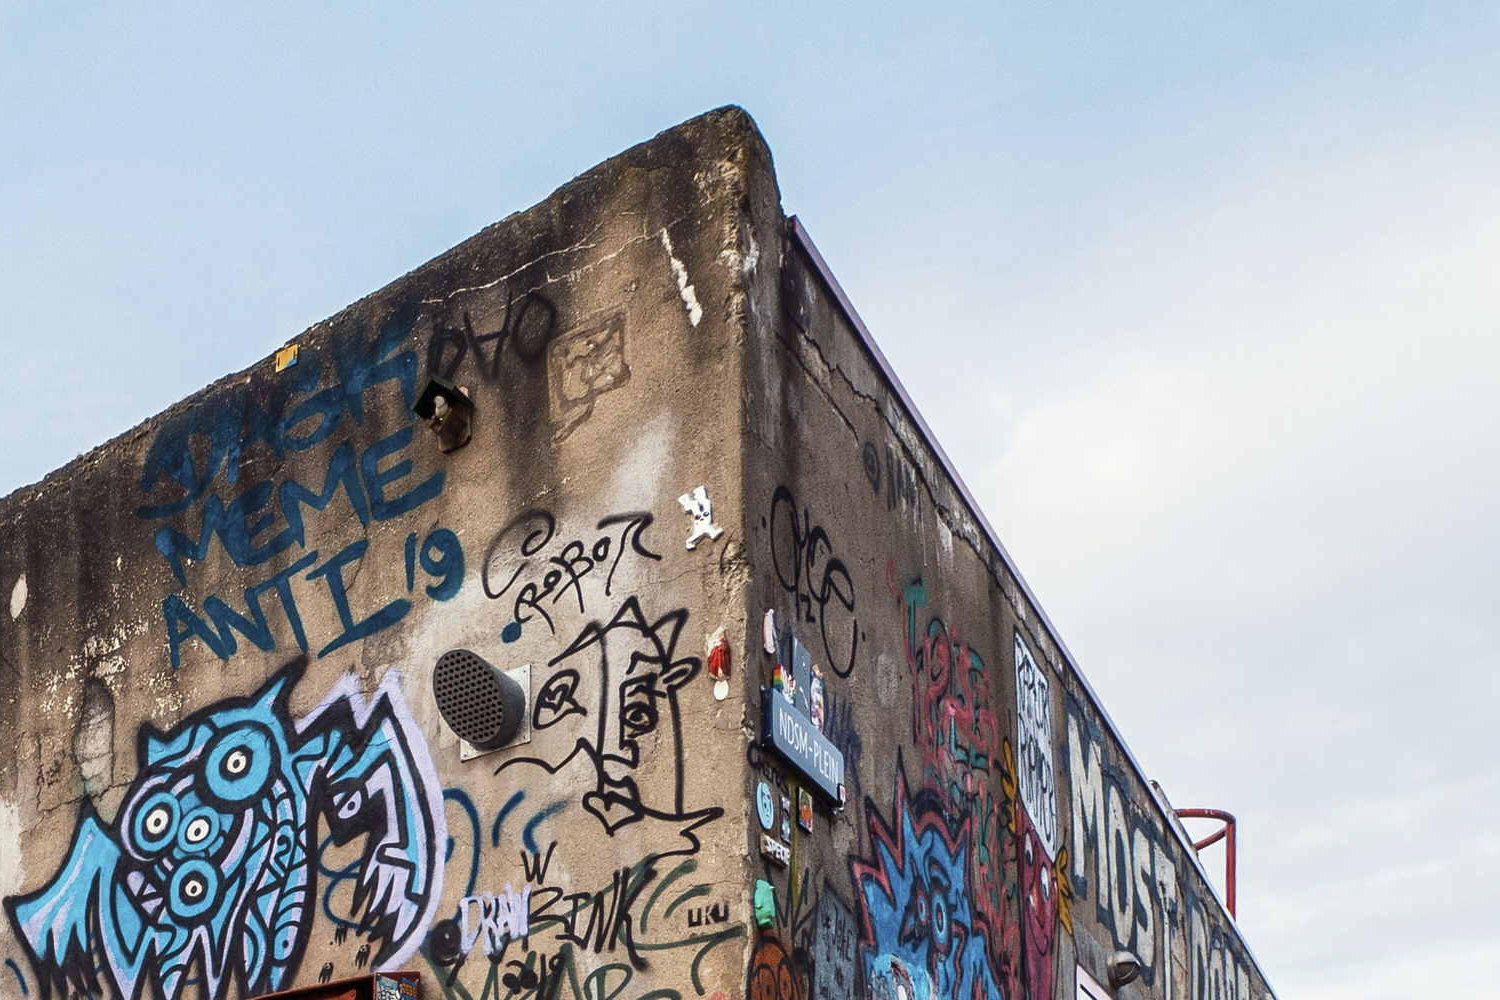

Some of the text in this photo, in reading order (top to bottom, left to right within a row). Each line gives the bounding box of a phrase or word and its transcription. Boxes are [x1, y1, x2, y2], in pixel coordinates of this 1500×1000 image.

[155, 424, 447, 587] MEME
[164, 539, 412, 670] ANTI
[778, 707, 840, 785] NDSM-PLEIN
